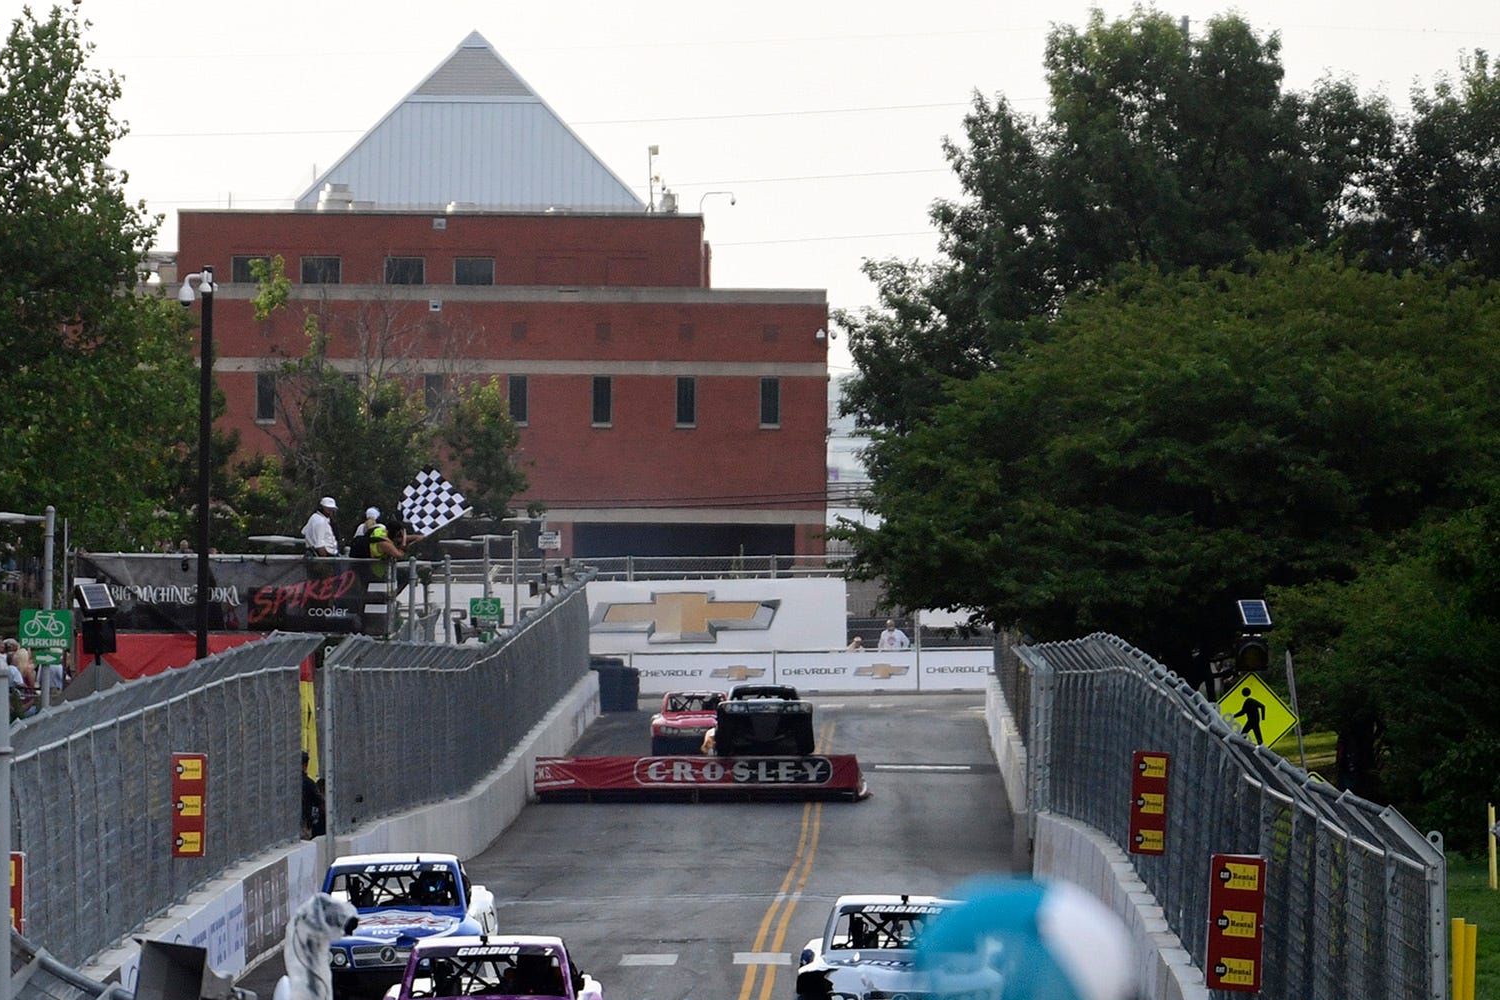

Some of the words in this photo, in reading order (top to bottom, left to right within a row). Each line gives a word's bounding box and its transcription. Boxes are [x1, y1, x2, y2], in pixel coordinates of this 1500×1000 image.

[111, 585, 131, 601] BIG
[131, 584, 196, 605] MACHINE
[247, 570, 356, 624] SPIKED
[307, 604, 349, 617] cooler
[21, 637, 68, 648] PARKING
[638, 668, 703, 678] CHEVROLET
[781, 666, 848, 676] CHEVROLET
[925, 665, 991, 674] CHEVROLET
[647, 761, 824, 782] CROSLEY
[378, 864, 420, 873] STOUT
[1232, 873, 1257, 881] Rental
[862, 904, 944, 915] BRABHAM
[1230, 920, 1254, 929] Rental
[457, 947, 520, 956] GORDON
[544, 948, 554, 956] 7
[1228, 967, 1252, 976] Rental
